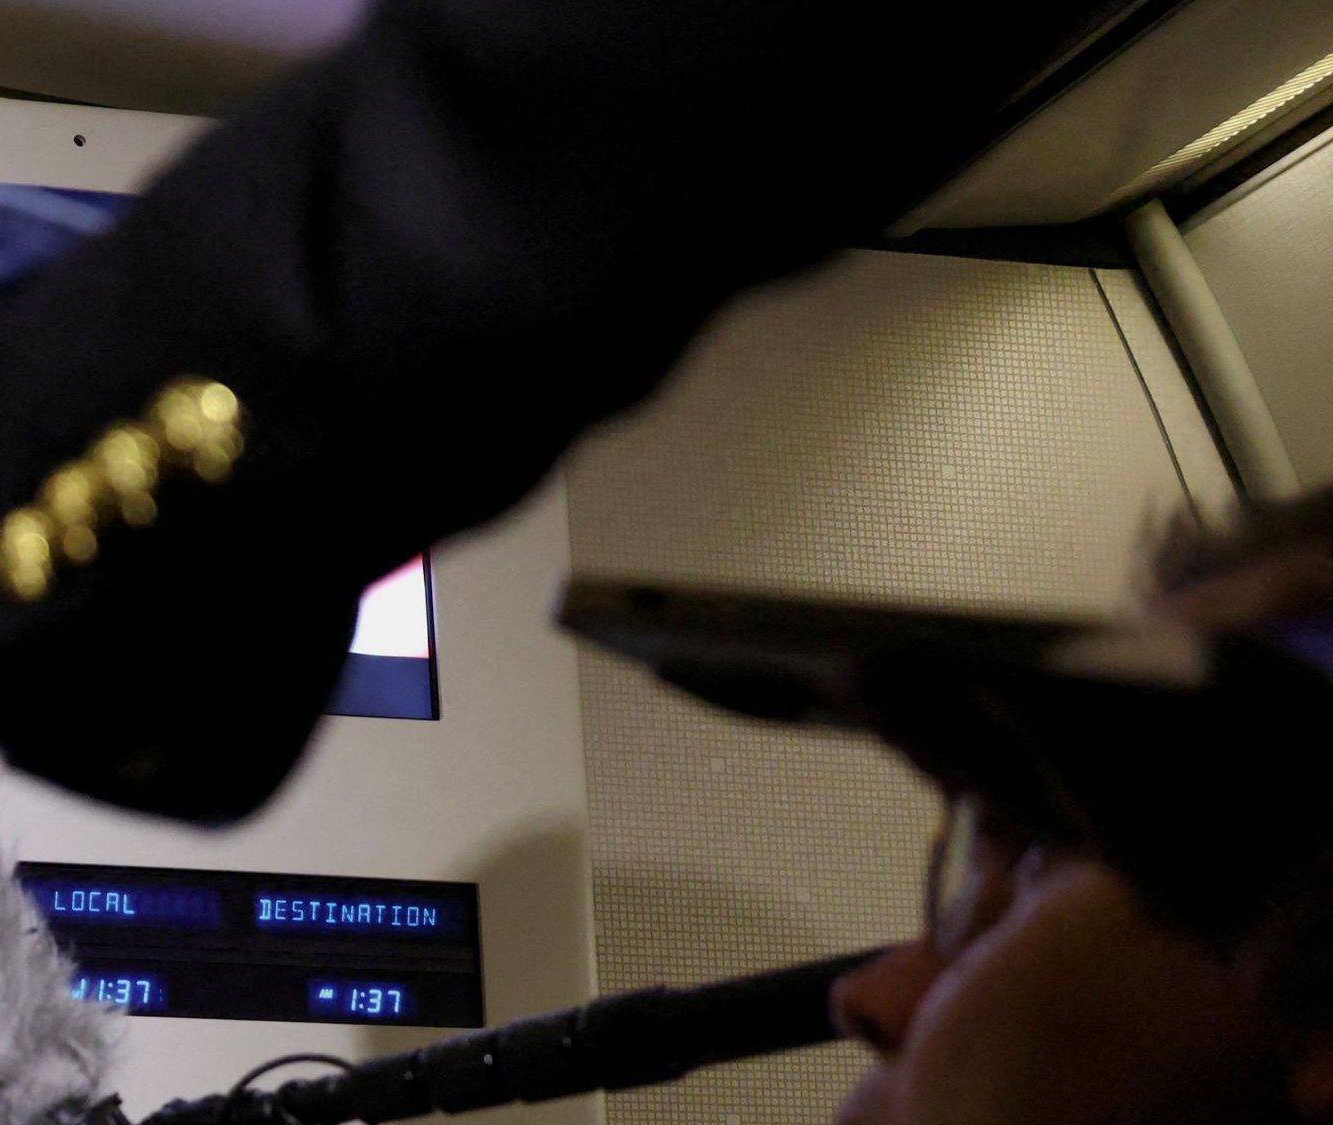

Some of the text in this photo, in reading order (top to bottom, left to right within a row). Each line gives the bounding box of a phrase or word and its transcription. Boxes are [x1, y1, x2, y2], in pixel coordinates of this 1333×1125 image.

[53, 890, 136, 915] LOCAL
[258, 898, 437, 927] DESTINATION
[318, 988, 401, 1014] AM 1:37
